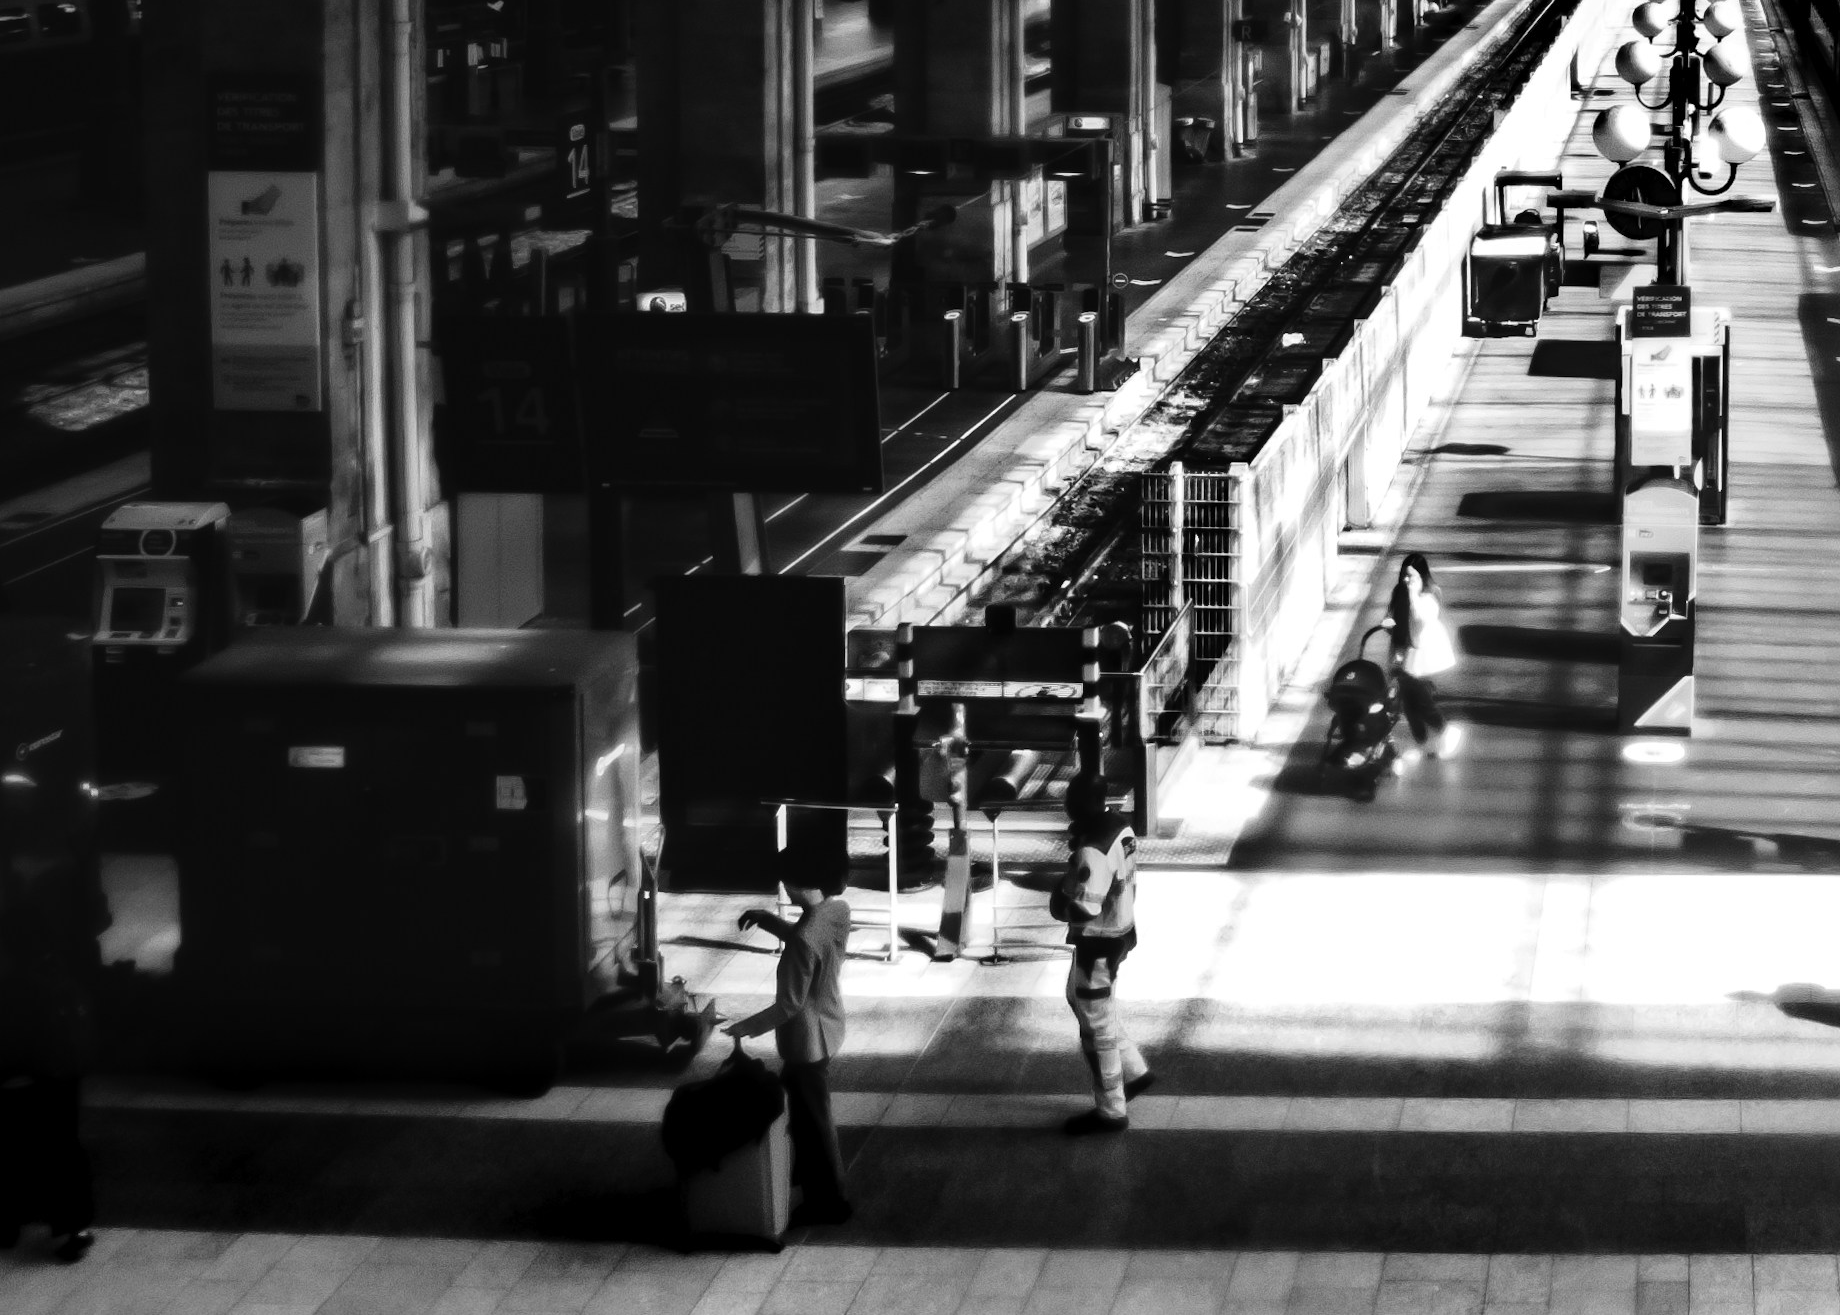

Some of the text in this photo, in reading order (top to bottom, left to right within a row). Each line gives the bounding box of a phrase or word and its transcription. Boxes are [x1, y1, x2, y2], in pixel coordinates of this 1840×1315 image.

[1241, 25, 1252, 40] R
[235, 121, 304, 133] TRANSPORT
[567, 144, 591, 189] 14
[476, 386, 552, 436] 14
